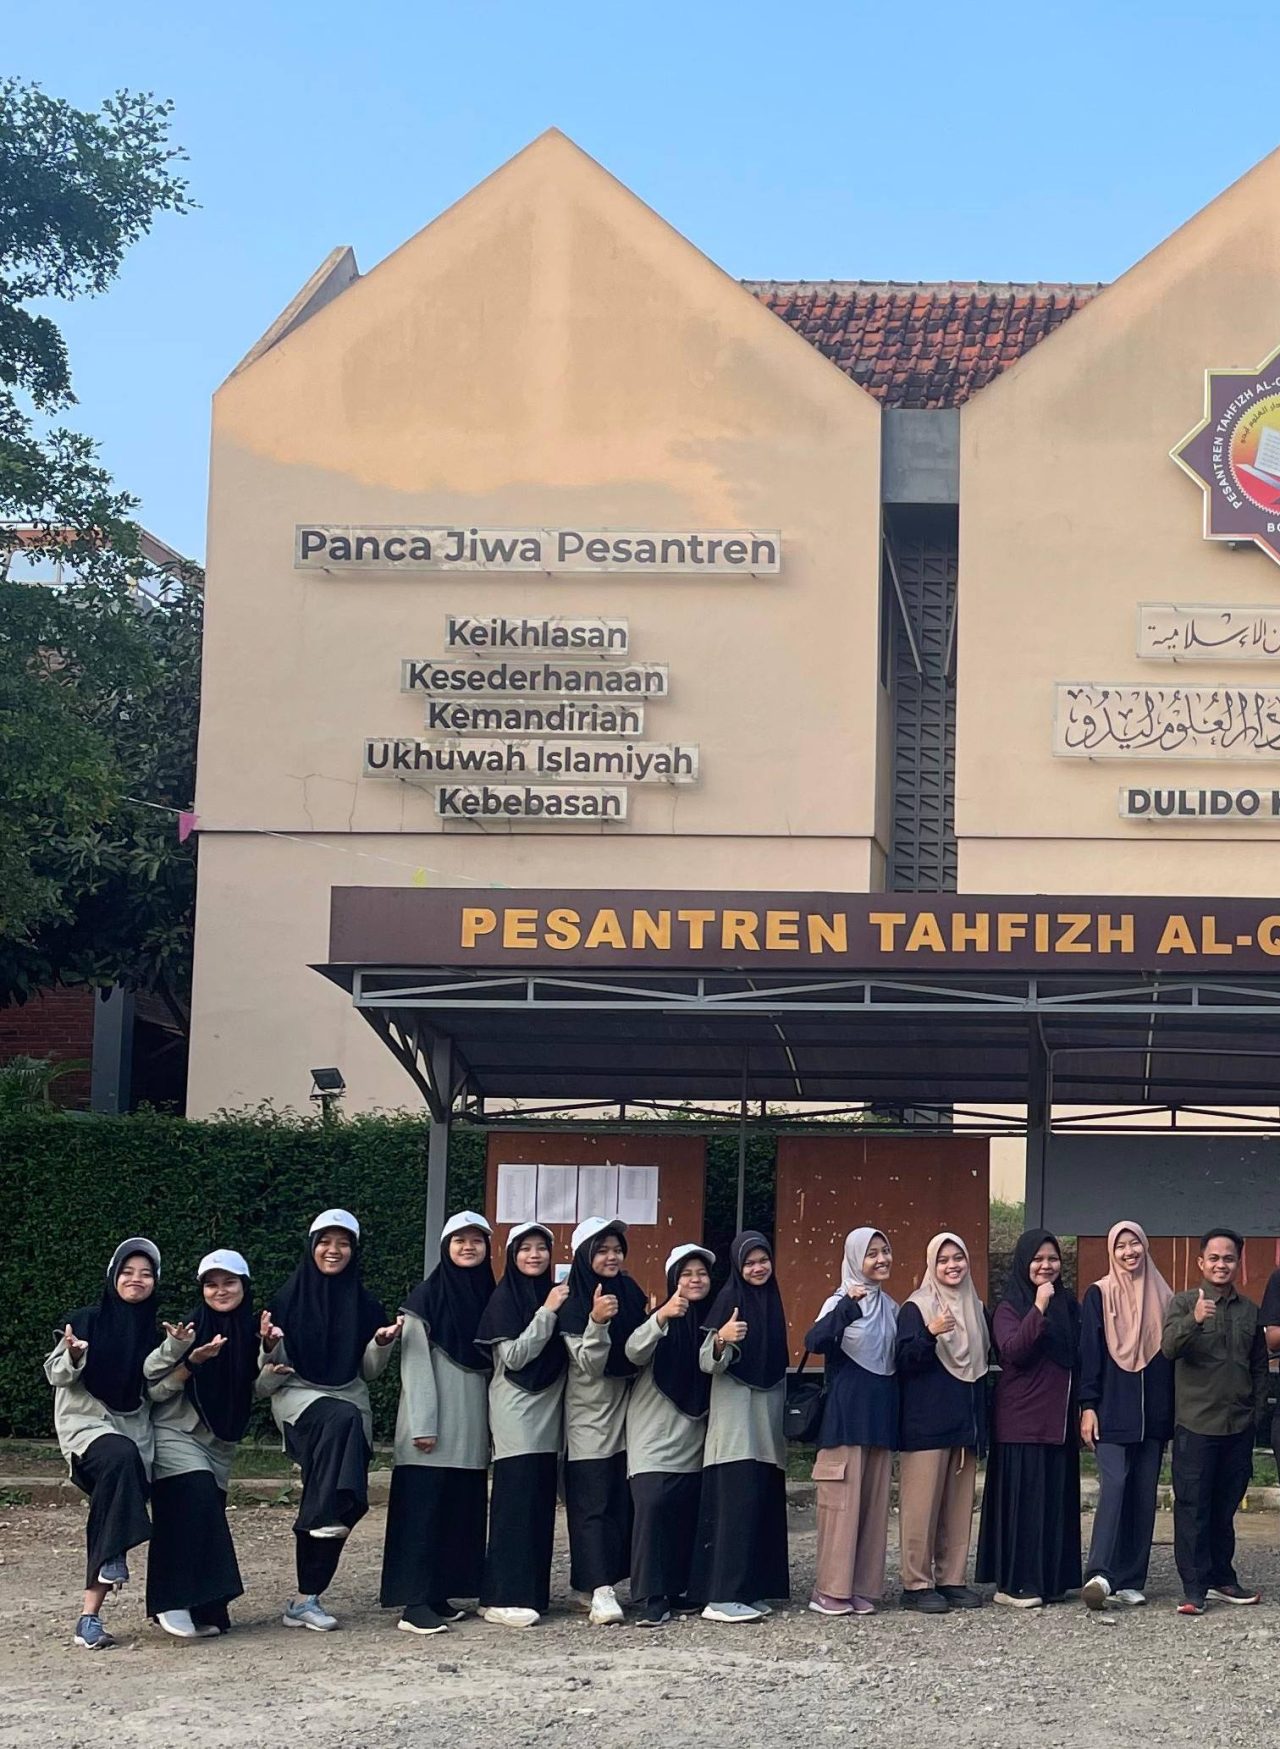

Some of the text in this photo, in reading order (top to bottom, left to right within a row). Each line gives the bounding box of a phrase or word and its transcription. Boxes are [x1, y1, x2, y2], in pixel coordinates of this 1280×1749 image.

[1216, 389, 1254, 433] TAHFIZH
[1212, 436, 1243, 510] PESANTREN
[301, 529, 776, 564] Panca Jiwa Pesantren
[449, 619, 626, 648] Keikhlasan
[409, 663, 663, 692] Kesederhanaan
[429, 703, 639, 732] Kemandirian
[367, 743, 693, 780] Ukhuwah Islamiyah
[439, 787, 620, 816] Kebebasan
[1128, 789, 1260, 815] DULIDO
[461, 907, 848, 954] PESANTREN
[870, 912, 1135, 953] TAHFIZH
